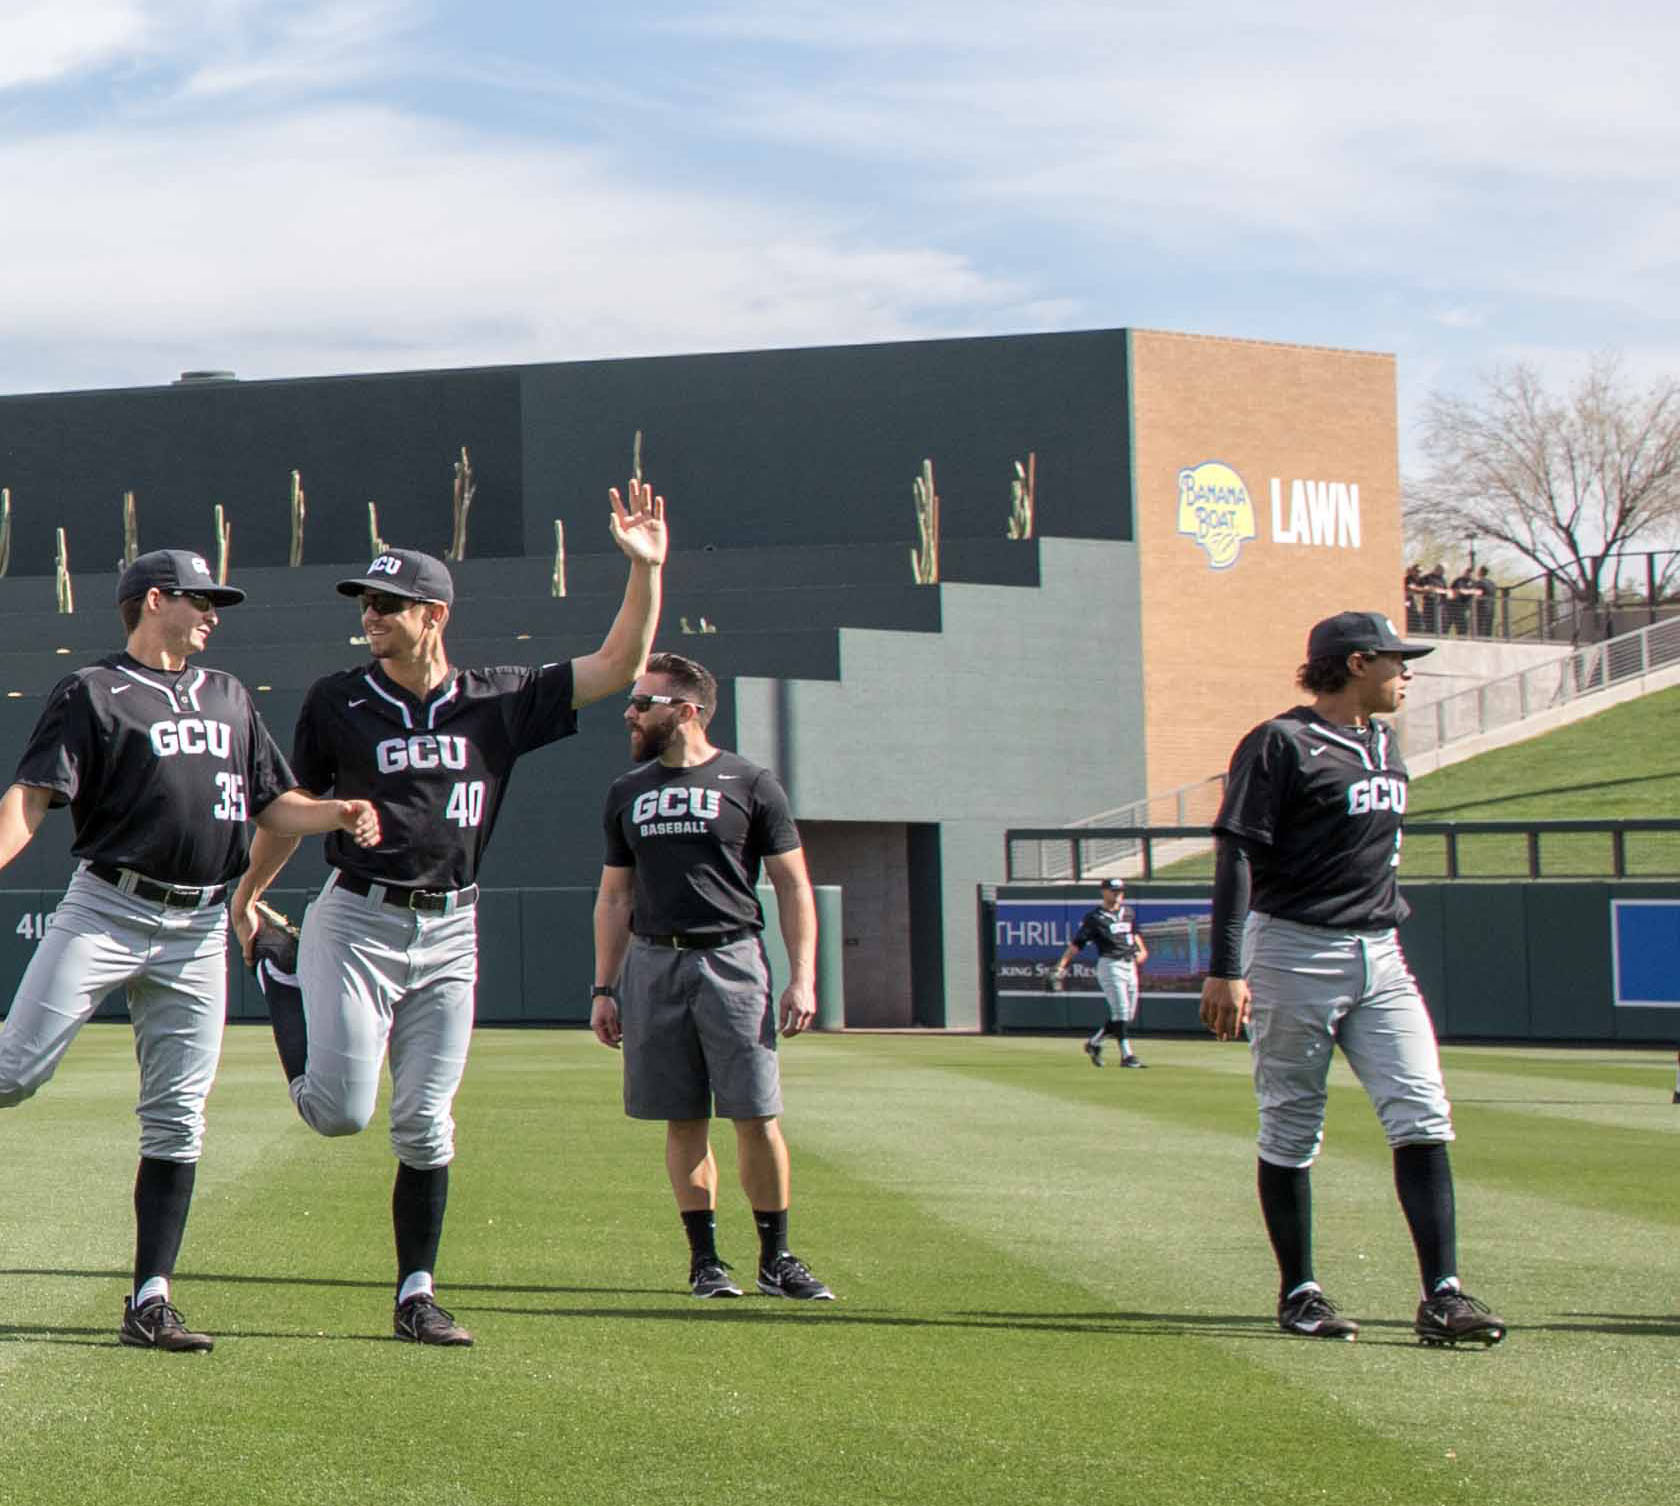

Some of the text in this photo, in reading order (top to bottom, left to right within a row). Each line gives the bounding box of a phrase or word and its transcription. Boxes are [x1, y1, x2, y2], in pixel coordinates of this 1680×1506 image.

[1195, 506, 1236, 539] BOAT
[1270, 478, 1361, 549] LAWN
[149, 718, 231, 759] GCU
[376, 735, 467, 774] GCU
[214, 771, 247, 821] 35
[446, 780, 485, 828] 40
[632, 786, 722, 824] GCU
[1348, 776, 1407, 815] GCU
[640, 821, 708, 837] BASEBALL
